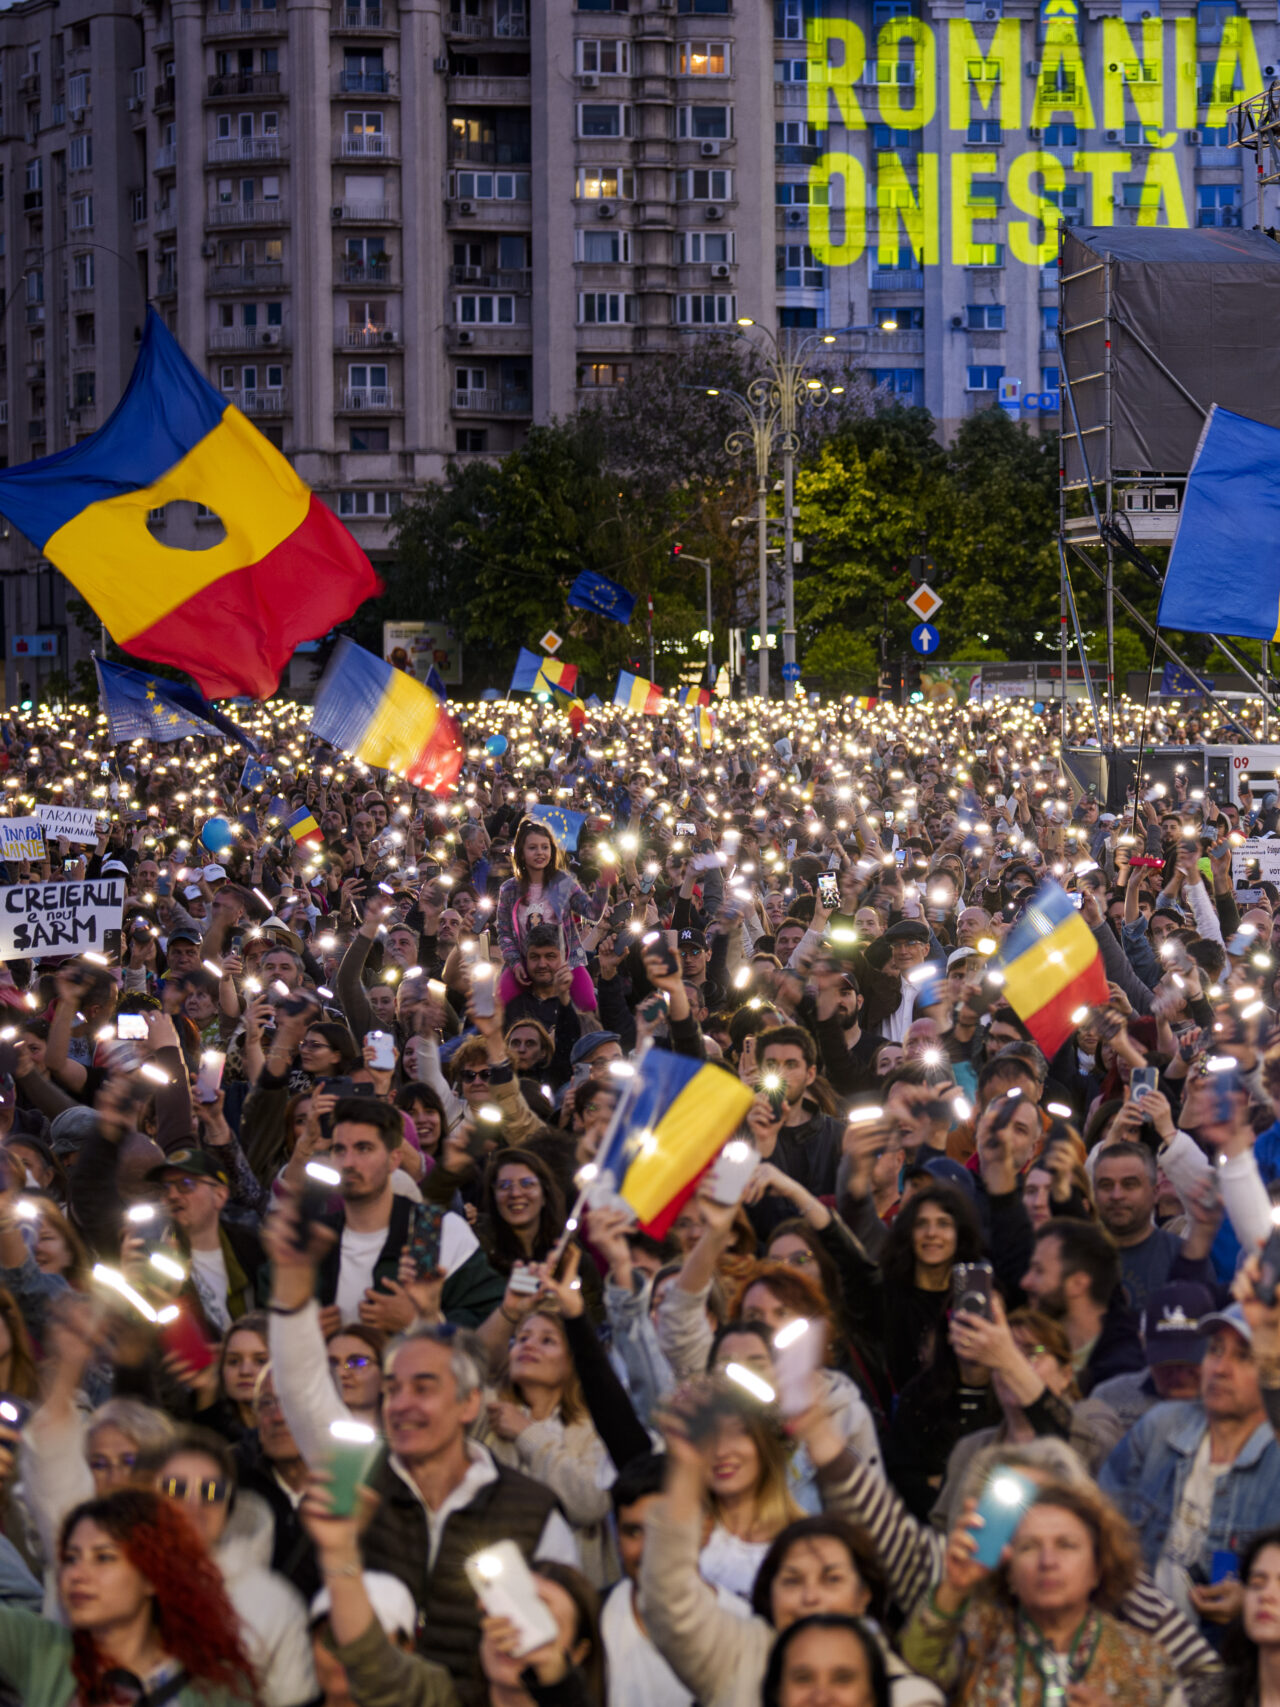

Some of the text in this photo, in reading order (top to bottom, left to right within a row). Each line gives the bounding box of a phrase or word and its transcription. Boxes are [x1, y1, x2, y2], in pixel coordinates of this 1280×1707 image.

[805, 0, 1265, 130] ROMÂNIA
[808, 130, 1189, 267] ONESTĂ
[1023, 393, 1060, 409] CO
[1233, 757, 1249, 769] 09
[5, 881, 122, 914] CREIERUL
[27, 906, 77, 923] e noul
